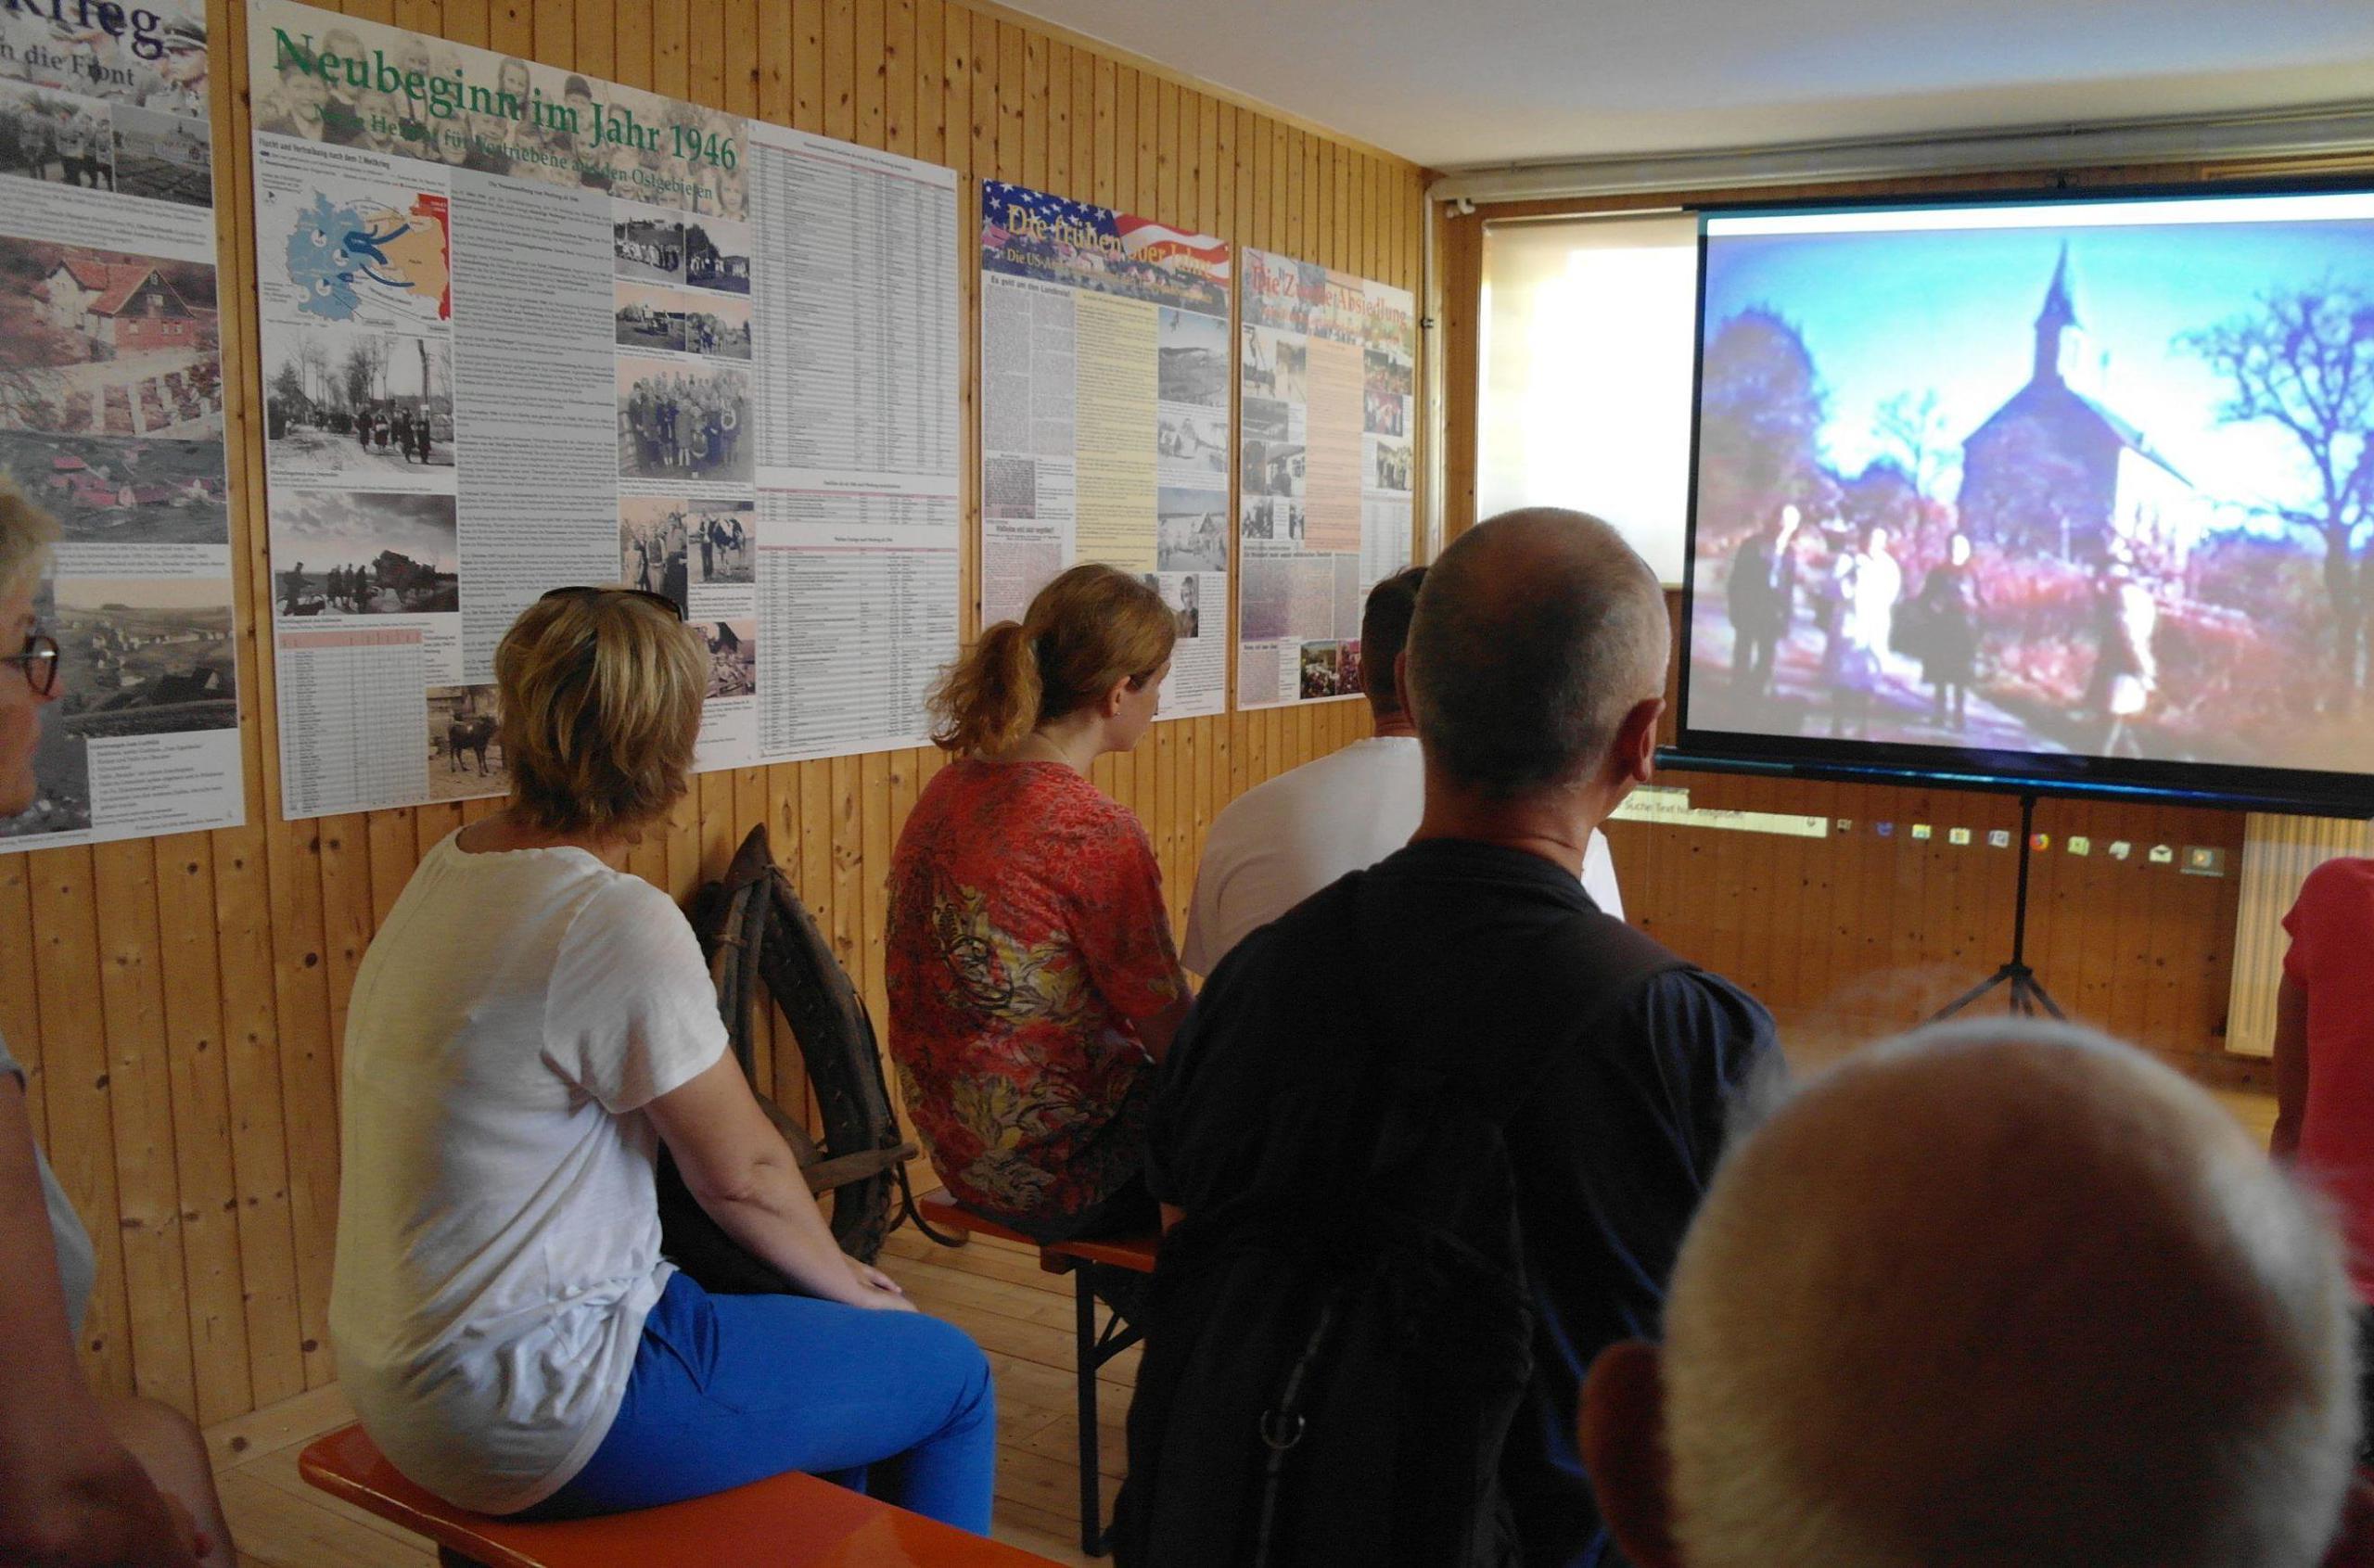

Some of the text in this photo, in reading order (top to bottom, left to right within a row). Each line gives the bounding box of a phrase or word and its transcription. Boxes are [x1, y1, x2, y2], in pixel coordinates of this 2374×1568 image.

[0, 0, 164, 60] rieg
[25, 45, 63, 70] die
[273, 26, 736, 171] Neubeginn im Jahr 1946
[474, 134, 568, 170] Vertriebene
[632, 168, 713, 200] Ostgebieten
[1007, 203, 1047, 241] Die
[1053, 214, 1121, 256] frühen
